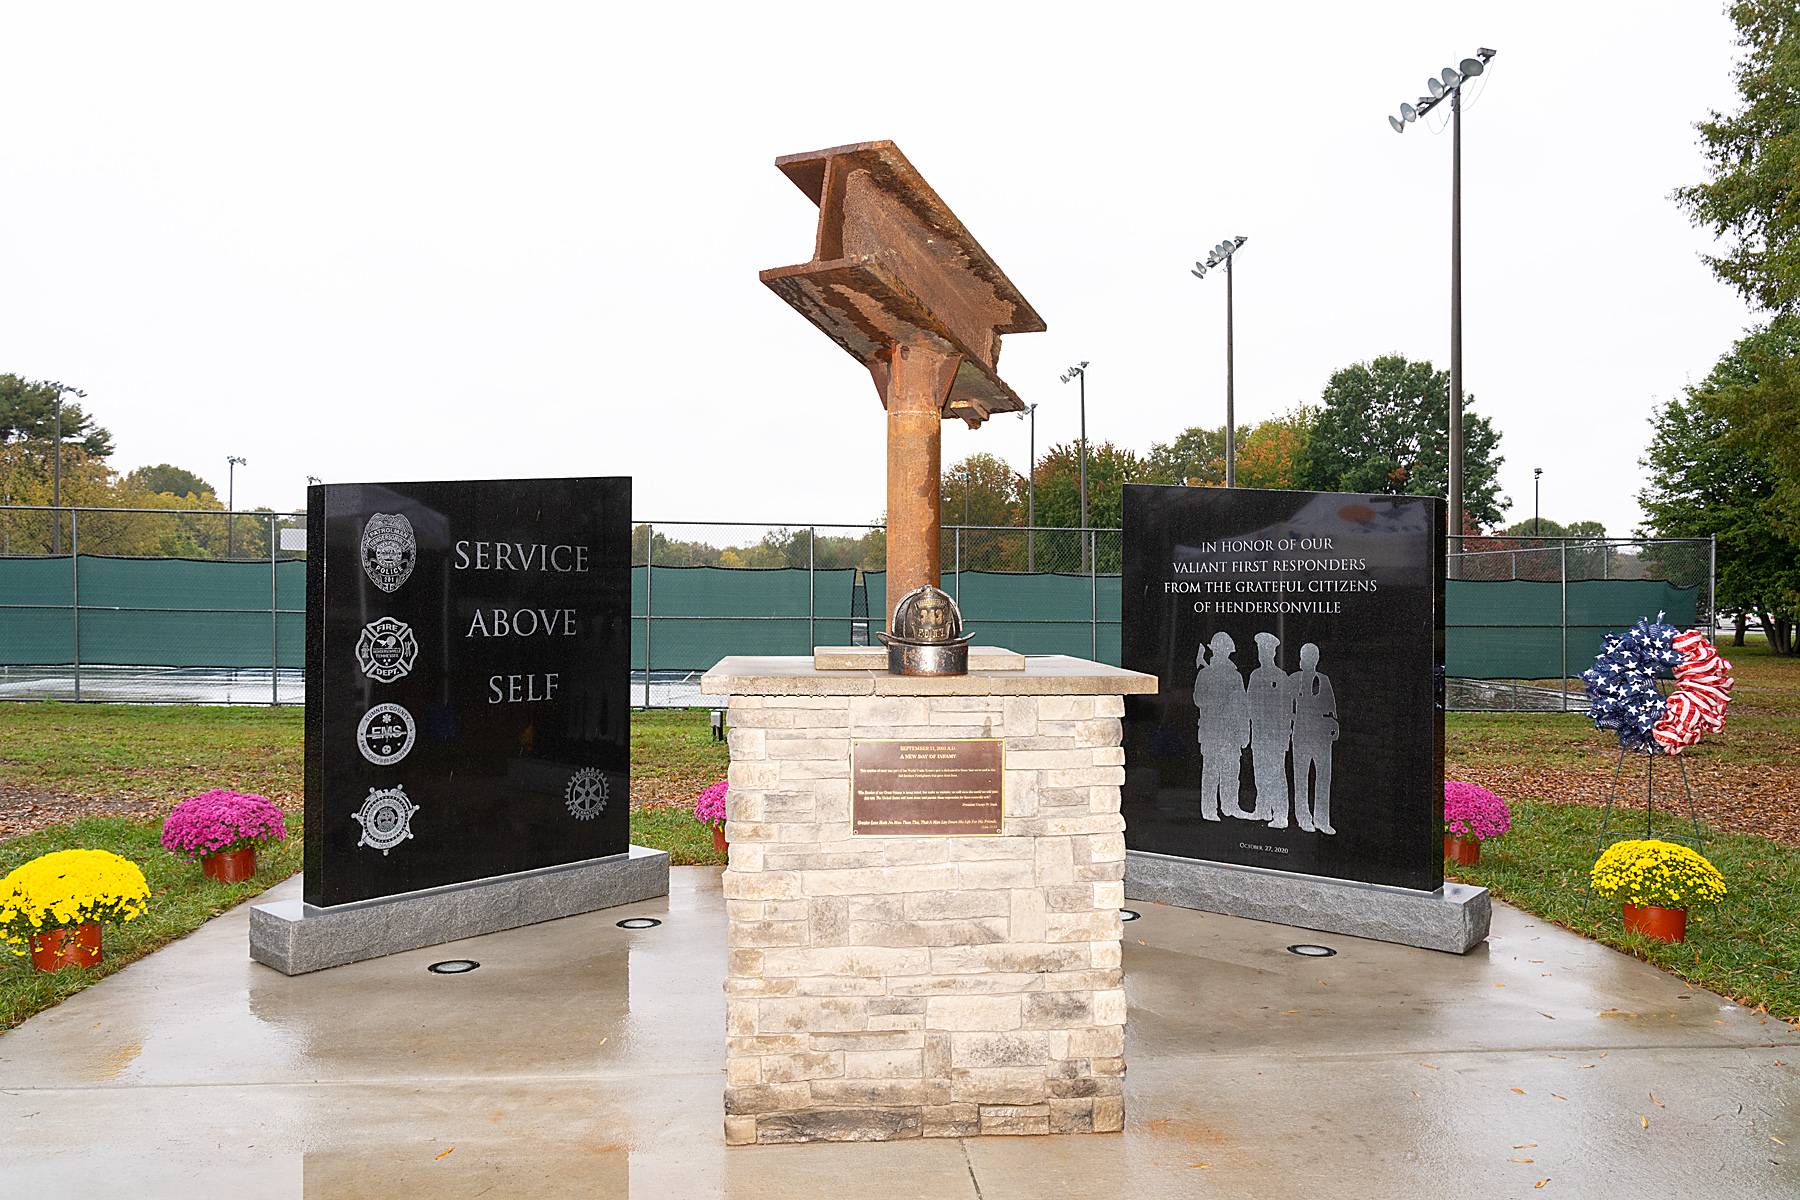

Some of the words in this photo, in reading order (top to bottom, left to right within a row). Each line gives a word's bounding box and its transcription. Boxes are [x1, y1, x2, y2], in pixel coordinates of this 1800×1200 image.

[370, 528, 408, 538] PATROLMAN
[1201, 541, 1217, 553] IN
[1221, 540, 1275, 552] HONOR
[1277, 539, 1297, 551] OF
[1300, 538, 1335, 550] OUR
[454, 540, 588, 572] SERVICE
[376, 566, 404, 574] POLICE
[1172, 562, 1228, 573] VALIANT
[1232, 560, 1268, 572] FIRST
[1273, 558, 1366, 571] RESPONDERS
[1164, 582, 1201, 593] FROM
[1204, 581, 1231, 593] THE
[1235, 580, 1304, 593] GRATEFUL
[1308, 579, 1377, 592] CITIZENS
[1193, 601, 1211, 613] OF
[1215, 601, 1341, 614] HENDERSONVILLE
[376, 624, 398, 632] FIRE
[466, 608, 577, 638] ABOVE
[376, 668, 400, 676] DEPT.
[488, 673, 560, 704] SELF
[365, 706, 388, 721] SUMNER
[388, 706, 410, 720] COUNTY
[372, 725, 402, 740] EMS
[1240, 842, 1264, 851] OCTOBER
[1274, 846, 1288, 854] 2020
